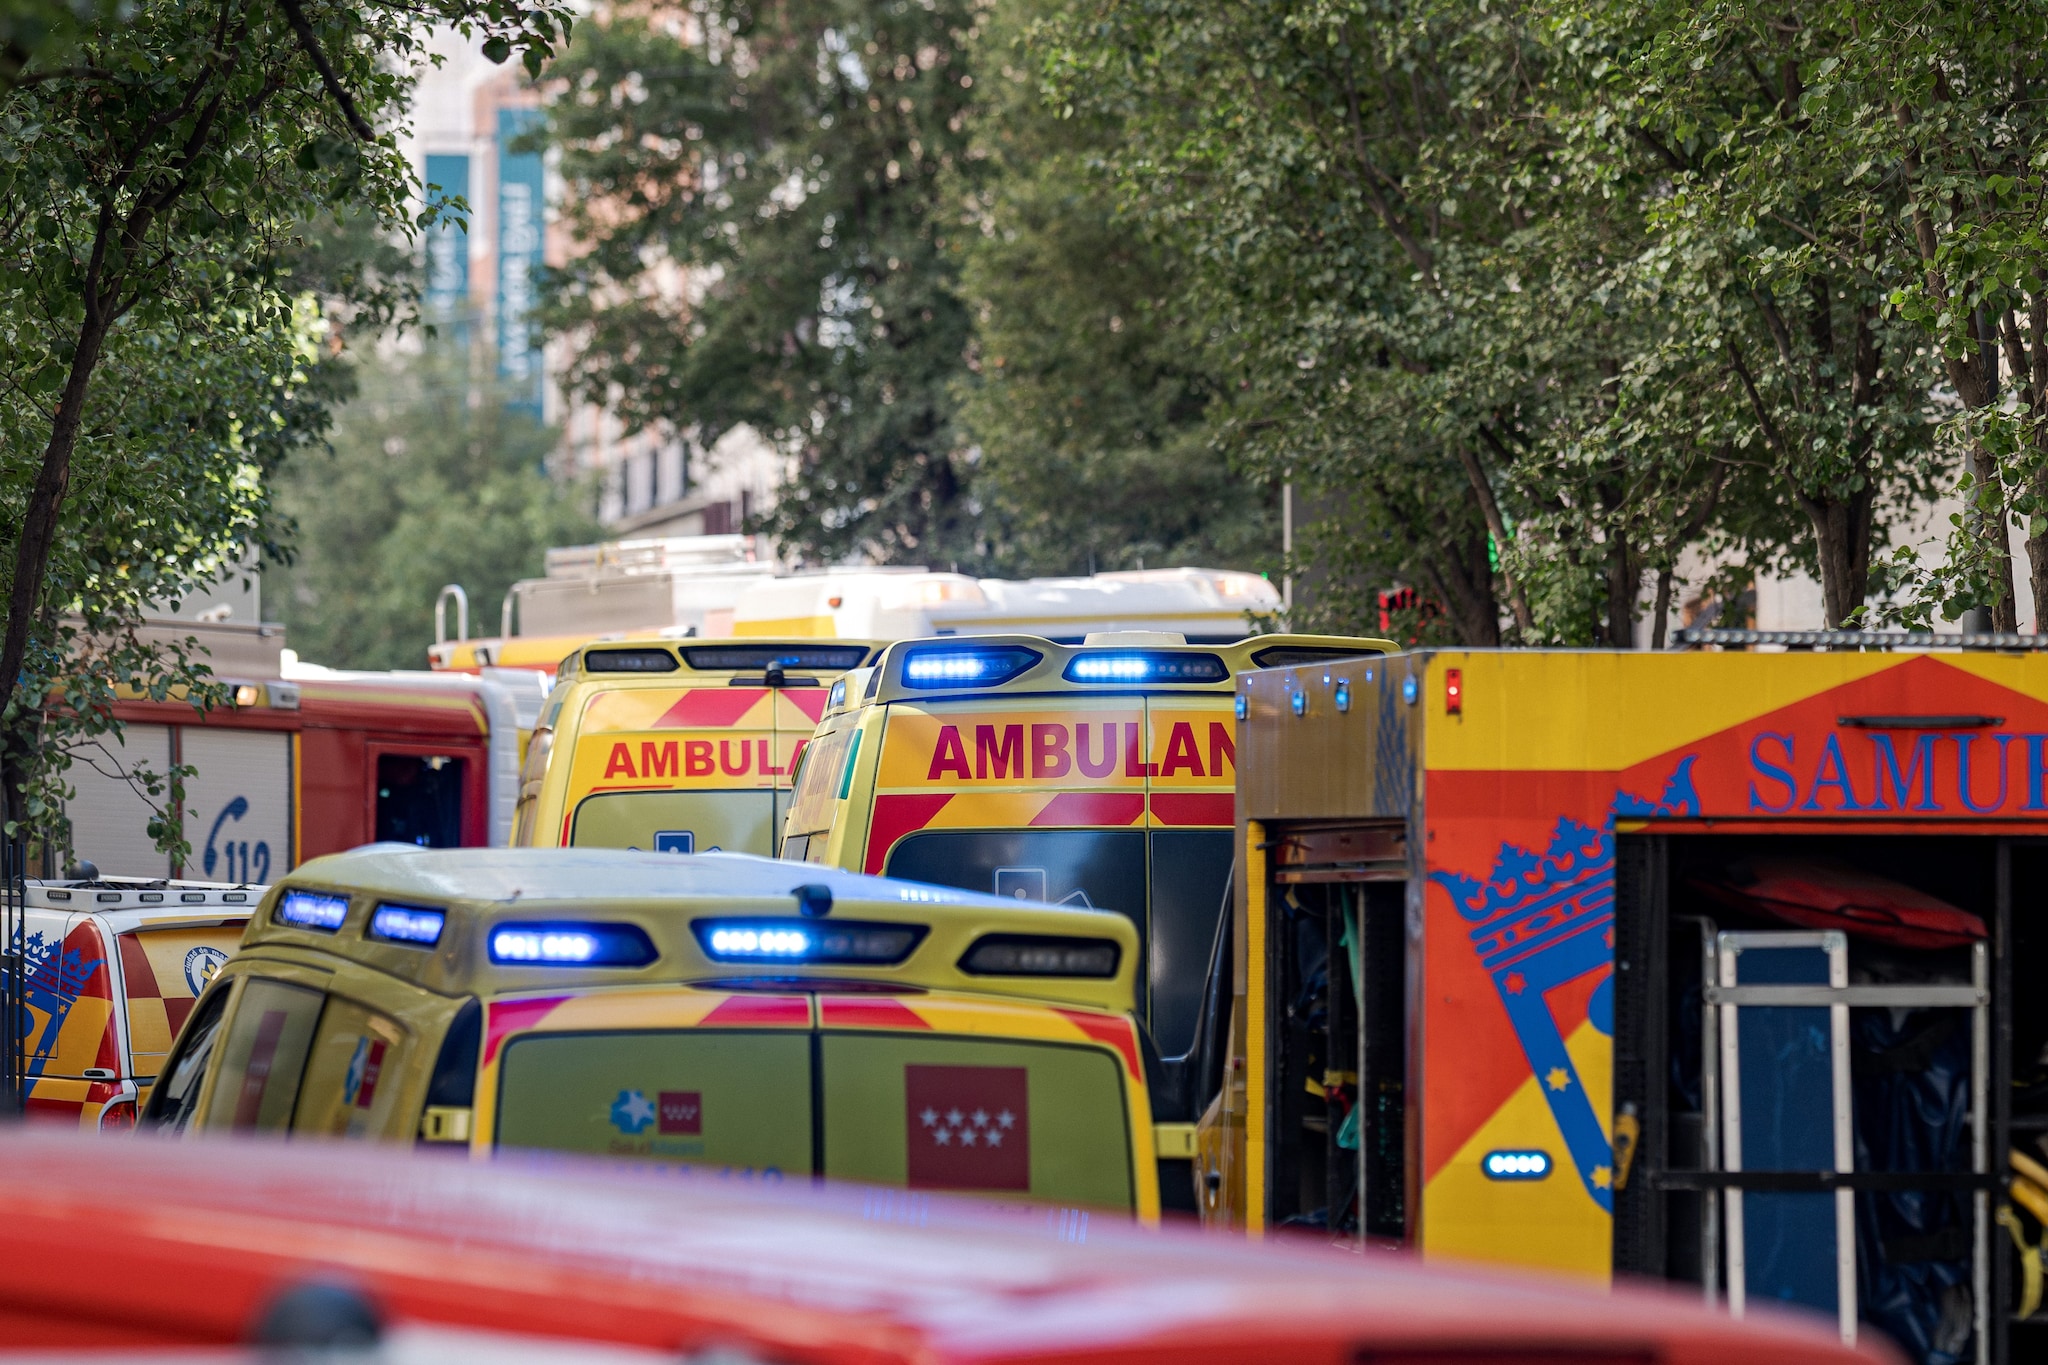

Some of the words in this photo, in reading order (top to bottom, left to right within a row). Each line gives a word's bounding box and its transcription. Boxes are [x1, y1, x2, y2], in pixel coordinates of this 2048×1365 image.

[927, 721, 1236, 780] AMBULAN
[225, 841, 271, 885] 112
[185, 949, 198, 974] ciudad
